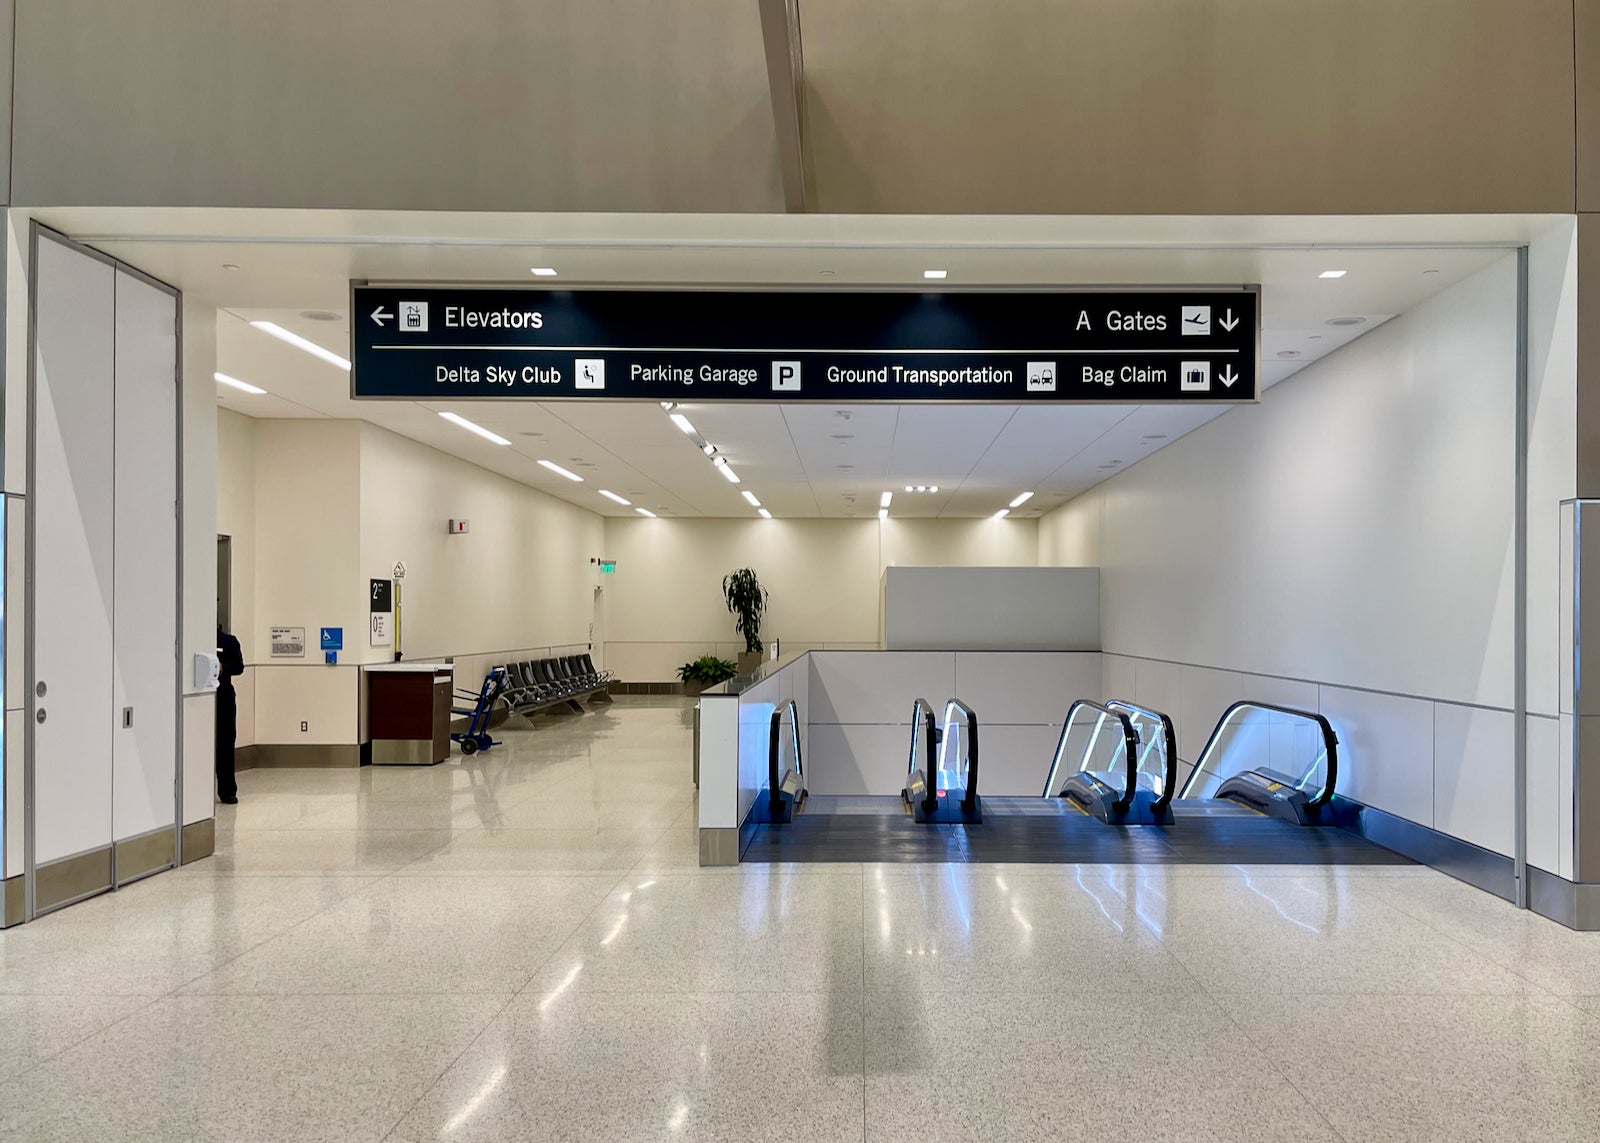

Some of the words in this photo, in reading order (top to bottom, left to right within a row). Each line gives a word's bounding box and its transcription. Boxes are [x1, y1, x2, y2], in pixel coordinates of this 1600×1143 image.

[445, 306, 543, 329] Elevators
[1075, 310, 1092, 331] A
[1106, 310, 1167, 331] Gates
[436, 365, 480, 383] Delta
[486, 365, 517, 387] Sky
[521, 366, 562, 384] Club
[631, 364, 694, 385] Parking
[699, 364, 758, 386] Garage
[779, 366, 794, 386] P
[827, 365, 888, 383] Ground
[891, 366, 1013, 387] Transportation
[1082, 366, 1115, 387] Bag
[1120, 365, 1167, 383] Claim
[373, 582, 378, 600] 2
